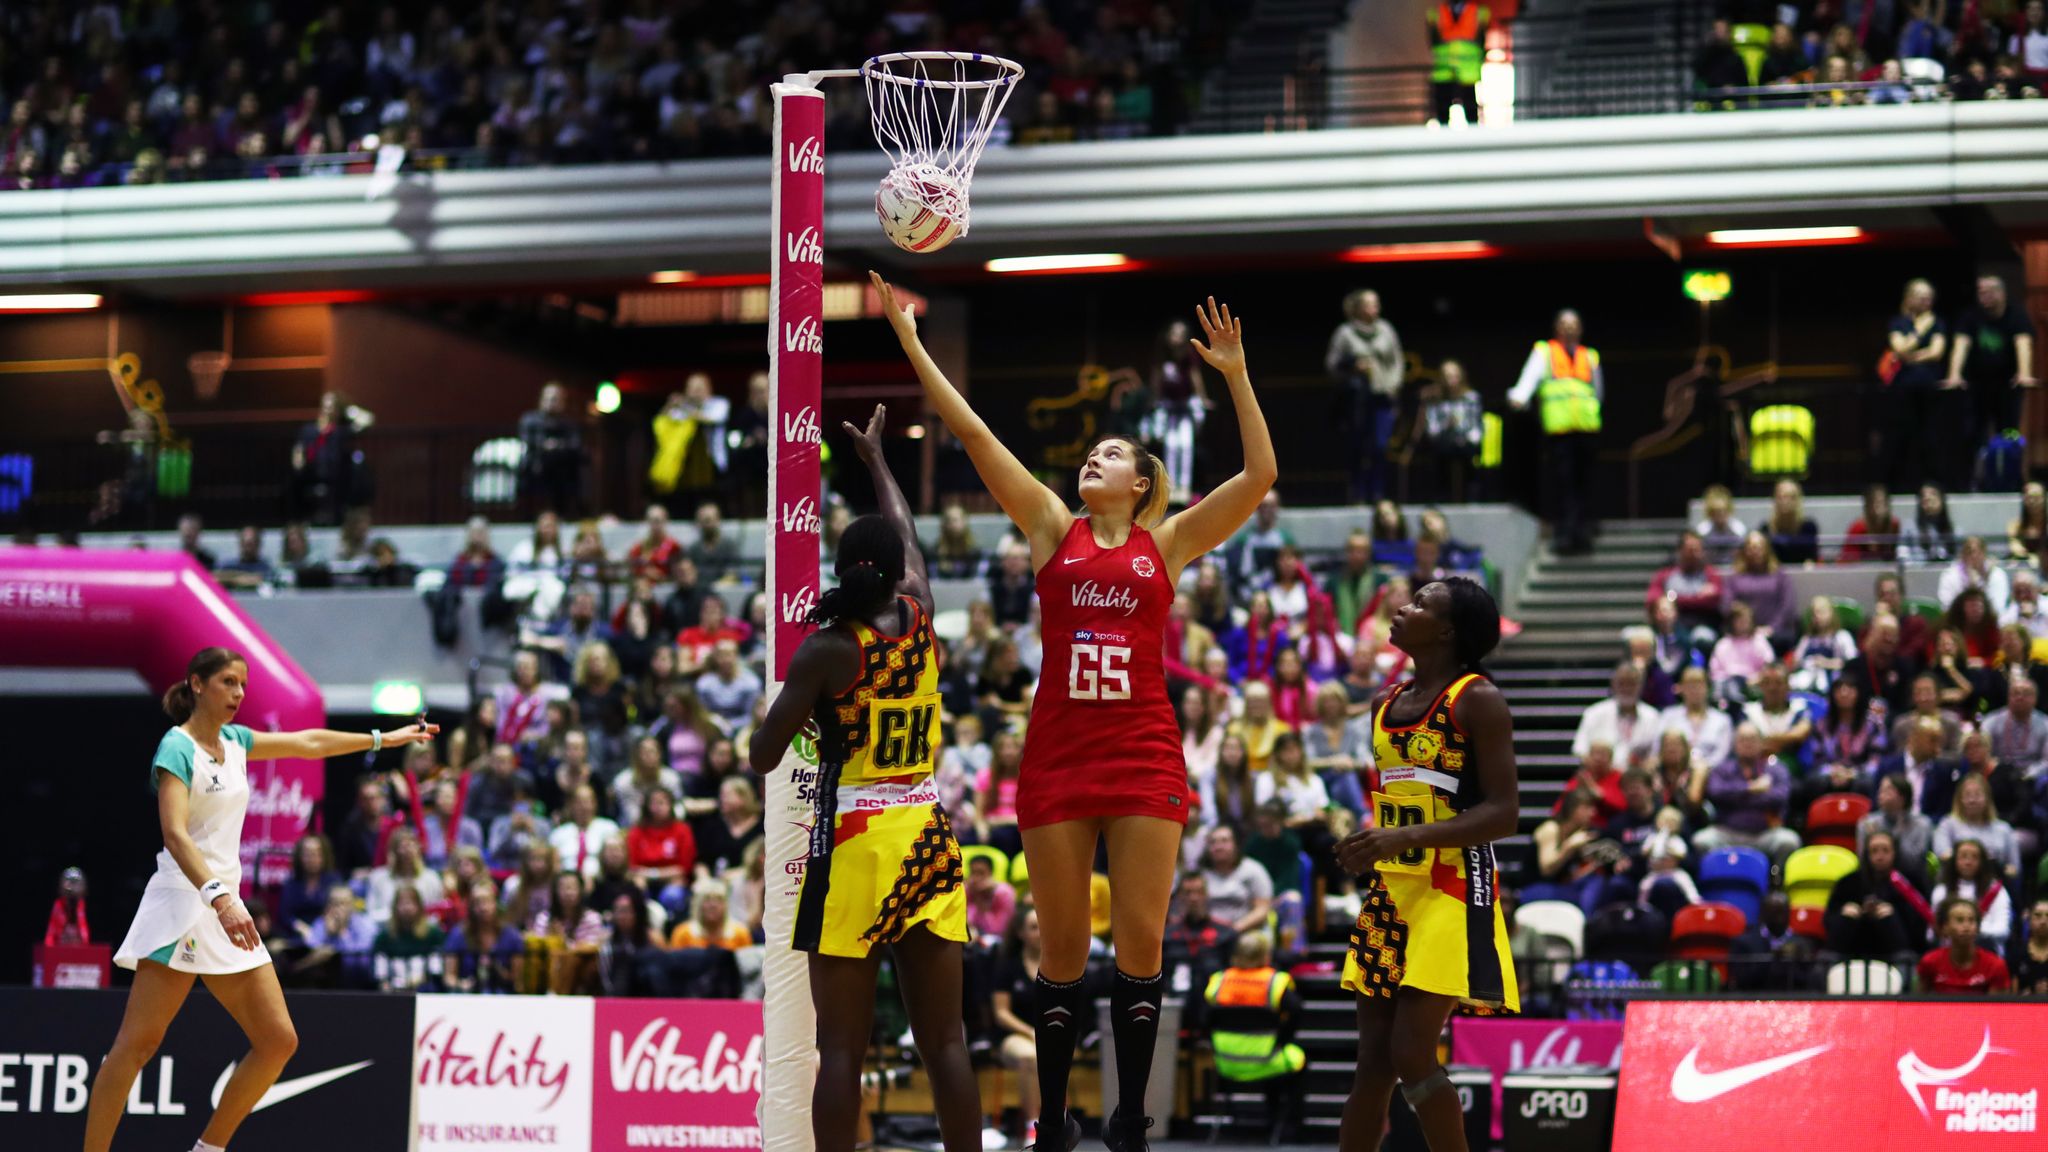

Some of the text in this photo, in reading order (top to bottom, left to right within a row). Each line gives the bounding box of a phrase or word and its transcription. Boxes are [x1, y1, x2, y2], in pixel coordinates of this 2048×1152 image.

[1071, 580, 1138, 616] Vitality
[1075, 631, 1126, 642] sky sports
[1069, 643, 1131, 700] GS
[873, 703, 935, 769] GK
[611, 1018, 762, 1093] Vitalit
[0, 1054, 187, 1115] ETBLL
[1936, 1087, 2038, 1117] England
[446, 1125, 557, 1143] INSURANCE
[1945, 1110, 2037, 1132] netball
